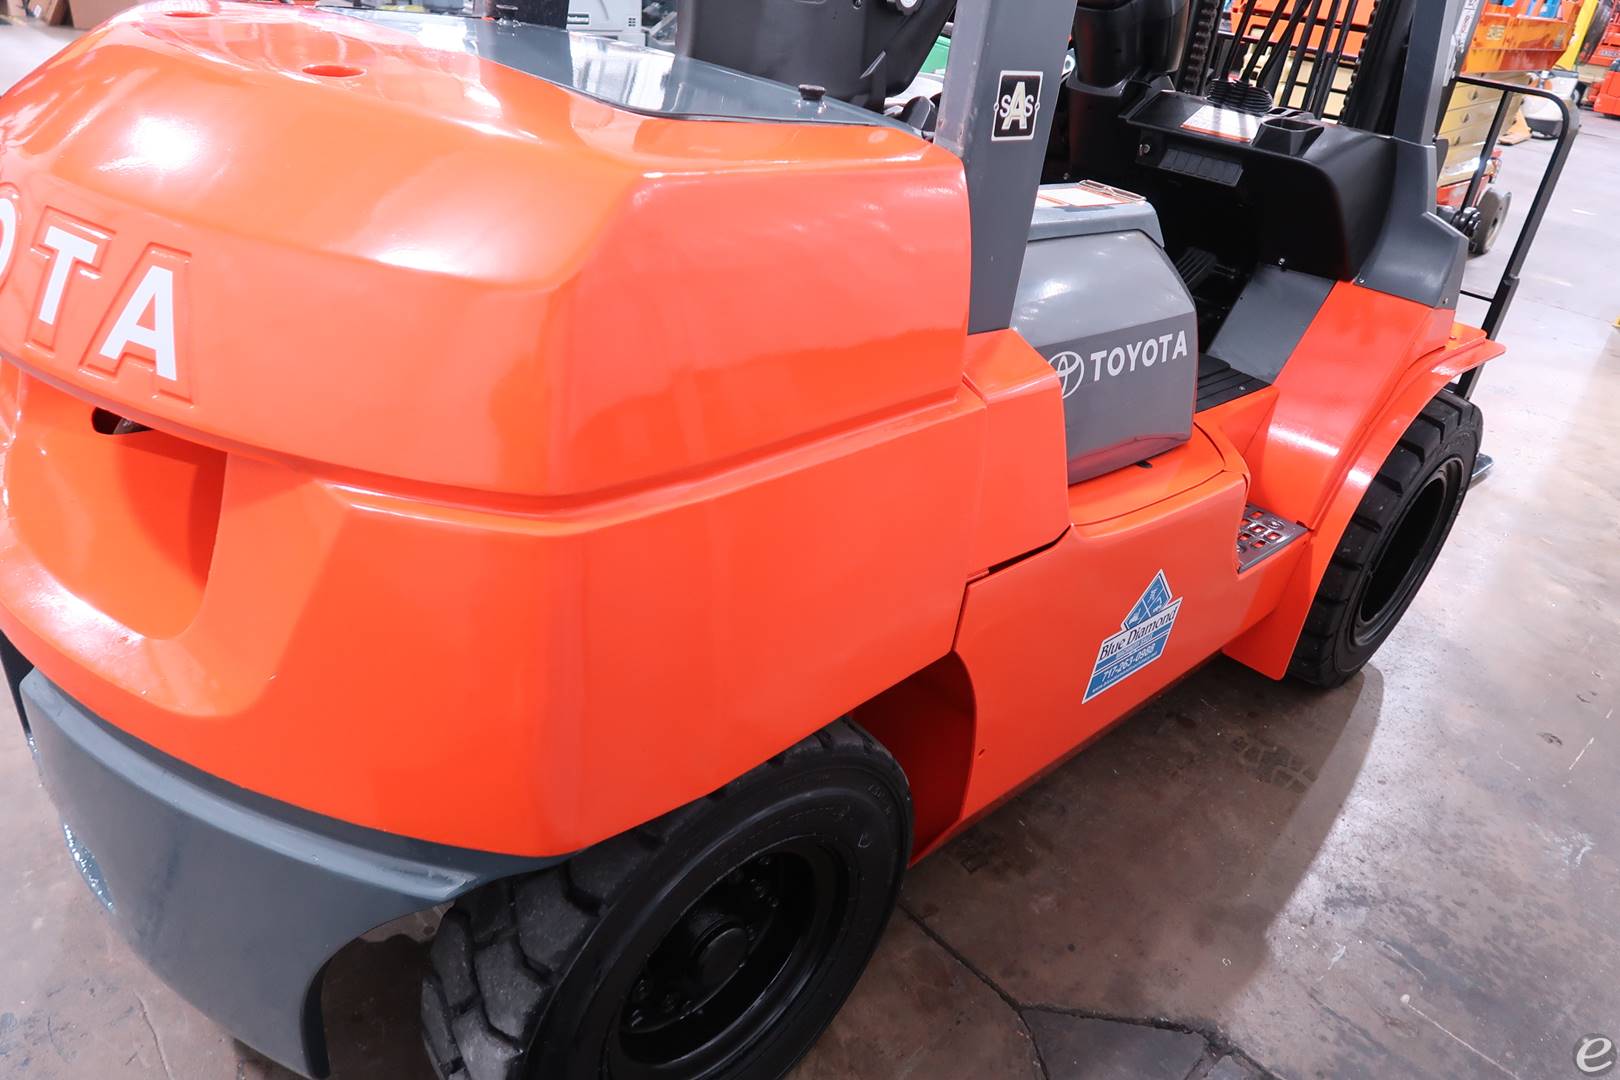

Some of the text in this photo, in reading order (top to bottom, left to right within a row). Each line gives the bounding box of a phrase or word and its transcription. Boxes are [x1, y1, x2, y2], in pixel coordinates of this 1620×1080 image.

[1091, 330, 1188, 382] TOYOTA
[1100, 639, 1125, 660] Blue
[1127, 606, 1177, 645] Diamond
